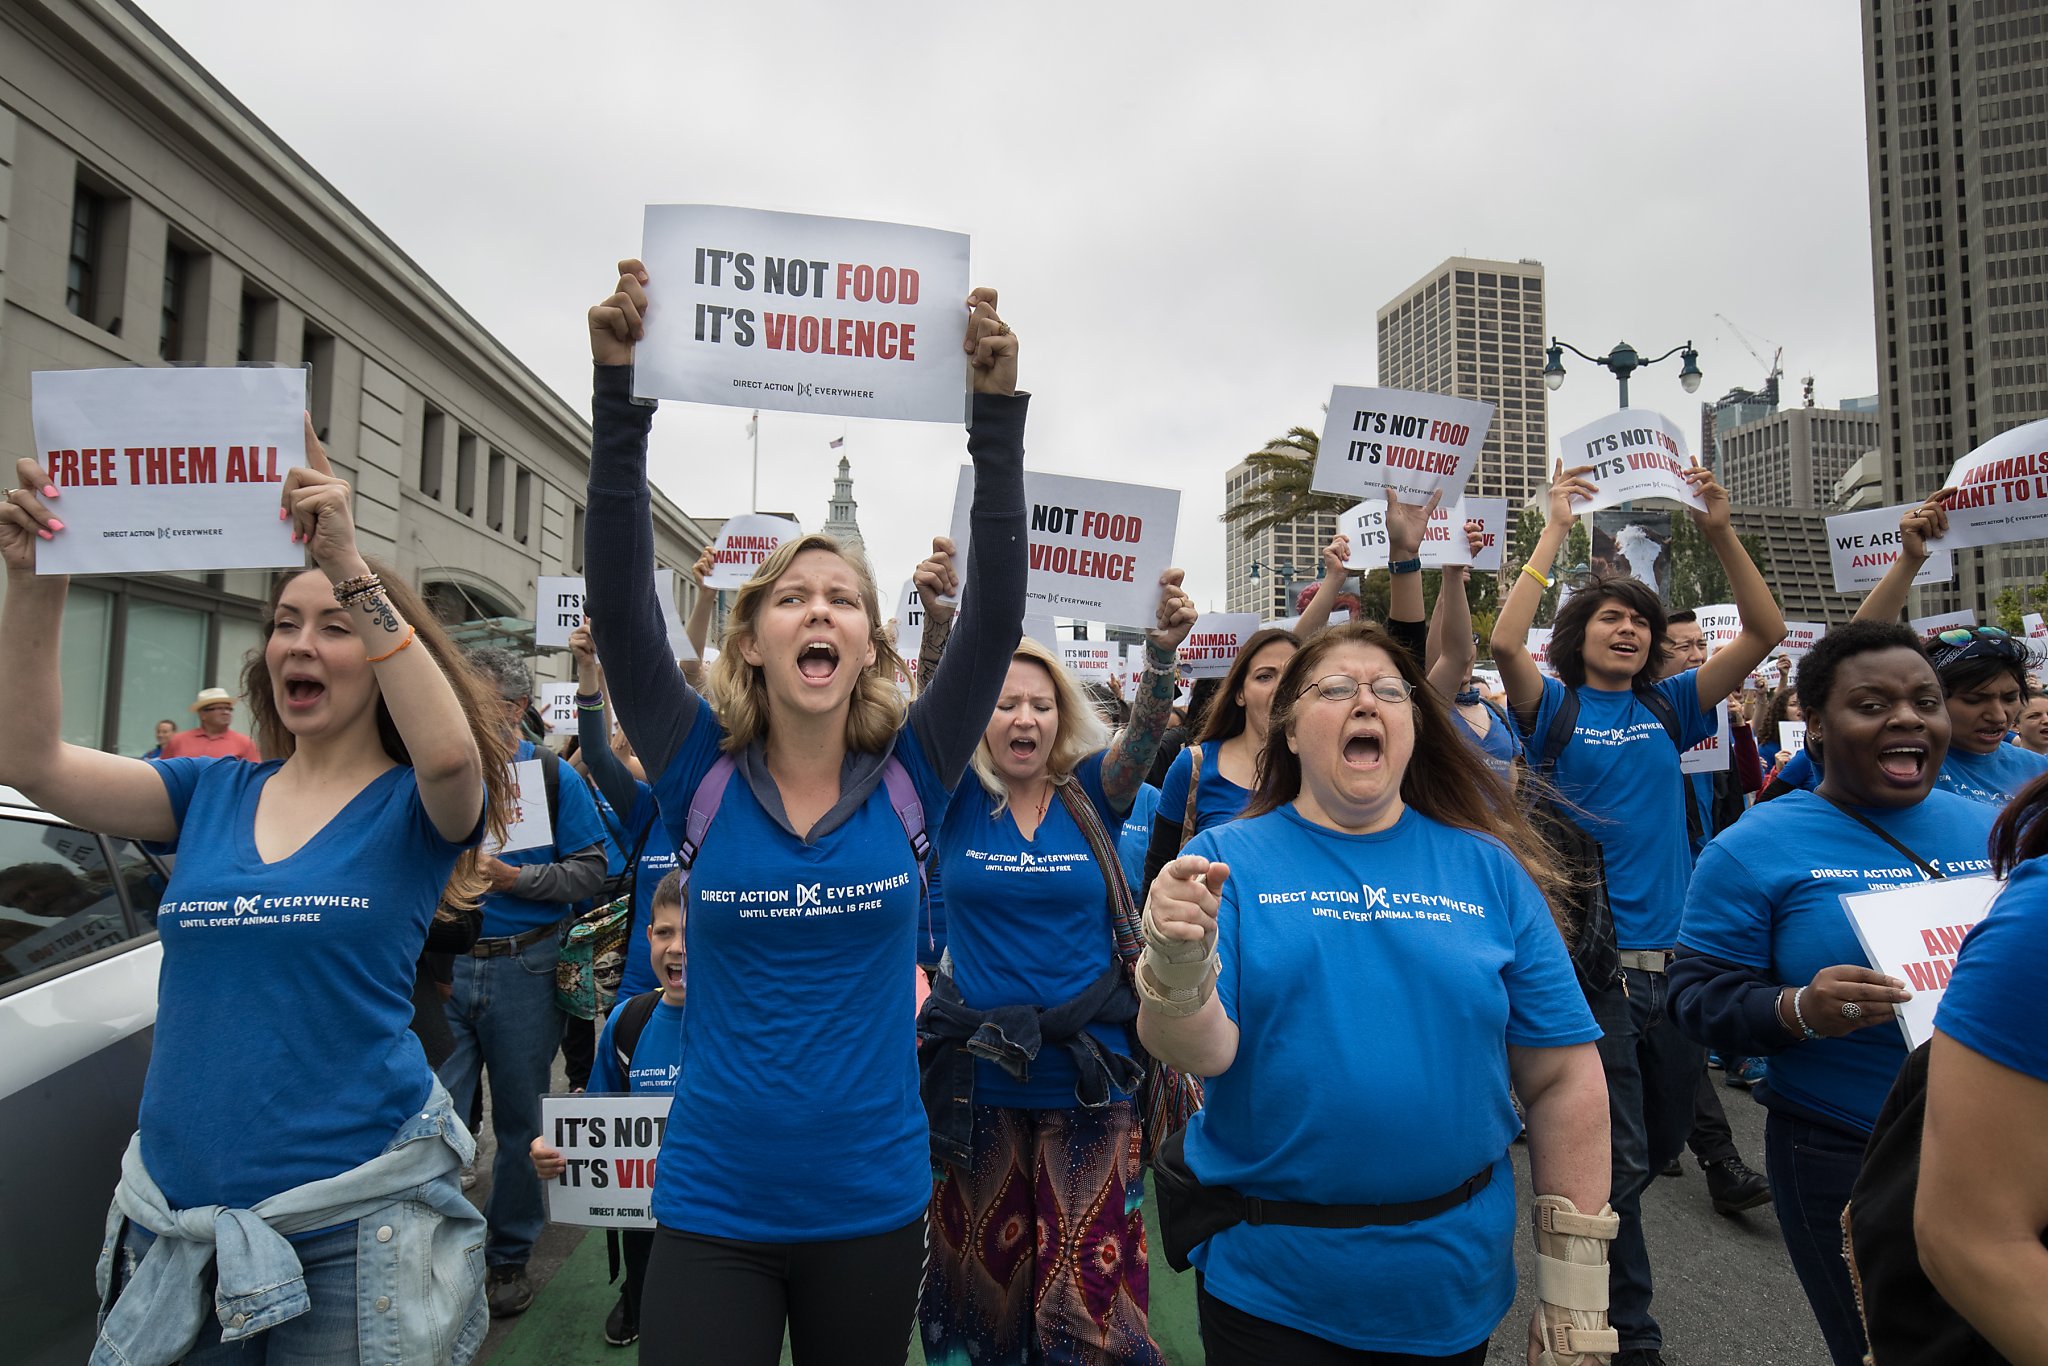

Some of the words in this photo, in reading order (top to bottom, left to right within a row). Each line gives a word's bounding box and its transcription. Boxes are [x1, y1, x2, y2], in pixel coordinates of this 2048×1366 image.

[694, 247, 755, 292] IT'S
[764, 256, 829, 299] NOT
[836, 263, 920, 305] FOOD
[694, 303, 755, 348] IT'S
[763, 312, 916, 361] VIOLENCE
[733, 379, 762, 390] DIRECT
[764, 382, 794, 392] ACTION
[814, 386, 874, 399] EVERYWHERE
[1352, 410, 1387, 434] IT'S
[1389, 414, 1429, 439] NOT
[1429, 420, 1470, 447] FOOD
[1586, 434, 1618, 458] IT'S
[1620, 428, 1654, 447] NOT
[1655, 430, 1680, 457] FOOD
[1347, 440, 1382, 464] IT'S
[1385, 445, 1460, 476] VIOLENCE
[48, 448, 117, 487] FREE
[124, 446, 217, 485] THEM
[225, 446, 282, 483] ALL
[1593, 457, 1625, 481] IT'S
[1626, 452, 1686, 481] VIOLENCE
[1961, 451, 2048, 486] ANIMALS
[2001, 479, 2030, 503] TO
[1031, 504, 1079, 535] NOT
[1081, 510, 1143, 543] FOOD
[1358, 511, 1382, 528] IT'S
[129, 530, 155, 538] ACTION
[172, 528, 223, 536] EVERYWHERE
[1361, 530, 1386, 546] IT'S
[1836, 535, 1864, 549] WE
[1870, 531, 1902, 546] ARE
[726, 535, 778, 550] ANIMALS
[714, 550, 748, 564] WANT
[1029, 543, 1136, 583] VIOLENCE
[1852, 551, 1897, 568] ANIM
[557, 594, 579, 608] IT'S
[1060, 596, 1102, 607] EVERYWHERE
[557, 613, 580, 627] IT'S
[1717, 616, 1737, 627] NOT
[1189, 633, 1237, 647] ANIMALS
[1794, 630, 1813, 639] FOOD
[1065, 649, 1077, 658] IT'S
[1078, 650, 1091, 658] NOT
[1091, 650, 1108, 659] FOOD
[1212, 647, 1225, 659] TO
[1078, 660, 1108, 669] VIOLENCE
[554, 695, 571, 705] IT'S
[554, 709, 571, 719] IT'S
[965, 849, 987, 861] DIRECT
[988, 853, 1018, 863] ACTION
[1037, 853, 1090, 863] EVERYWHERE
[1004, 865, 1025, 873] EVERY
[1025, 865, 1049, 873] ANIMAL
[1810, 868, 1859, 879] DIRECT
[1863, 867, 1913, 878] ACTION
[701, 889, 736, 903] DIRECT
[739, 889, 789, 903] ACTION
[826, 872, 910, 899] EVERYWHERE
[1868, 882, 1900, 891] UNTIL
[179, 901, 229, 913] ACTION
[264, 895, 370, 909] EVERYWHERE
[739, 909, 769, 918] UNTIL
[770, 908, 802, 918] EVERY
[805, 905, 844, 917] ANIMAL
[846, 903, 856, 912] IS
[858, 899, 882, 911] FREE
[1258, 890, 1306, 904] DIRECT
[1310, 890, 1359, 904] ACTION
[1392, 893, 1486, 918] EVERYWHERE
[180, 919, 208, 928] UNTIL
[209, 917, 240, 927] EVERY
[242, 915, 279, 926] ANIMAL
[281, 914, 291, 923] IS
[293, 913, 321, 922] FREE
[1311, 907, 1342, 920] UNTIL
[1342, 910, 1374, 923] EVERY
[1374, 909, 1414, 919] ANIMAL
[1415, 911, 1425, 919] IS
[1427, 912, 1452, 923] FREE
[640, 1068, 666, 1077] ACTION
[555, 1116, 606, 1148] IT'S
[614, 1116, 668, 1148] NOT
[589, 1207, 615, 1217] DIRECT
[616, 1207, 644, 1217] ACTION
